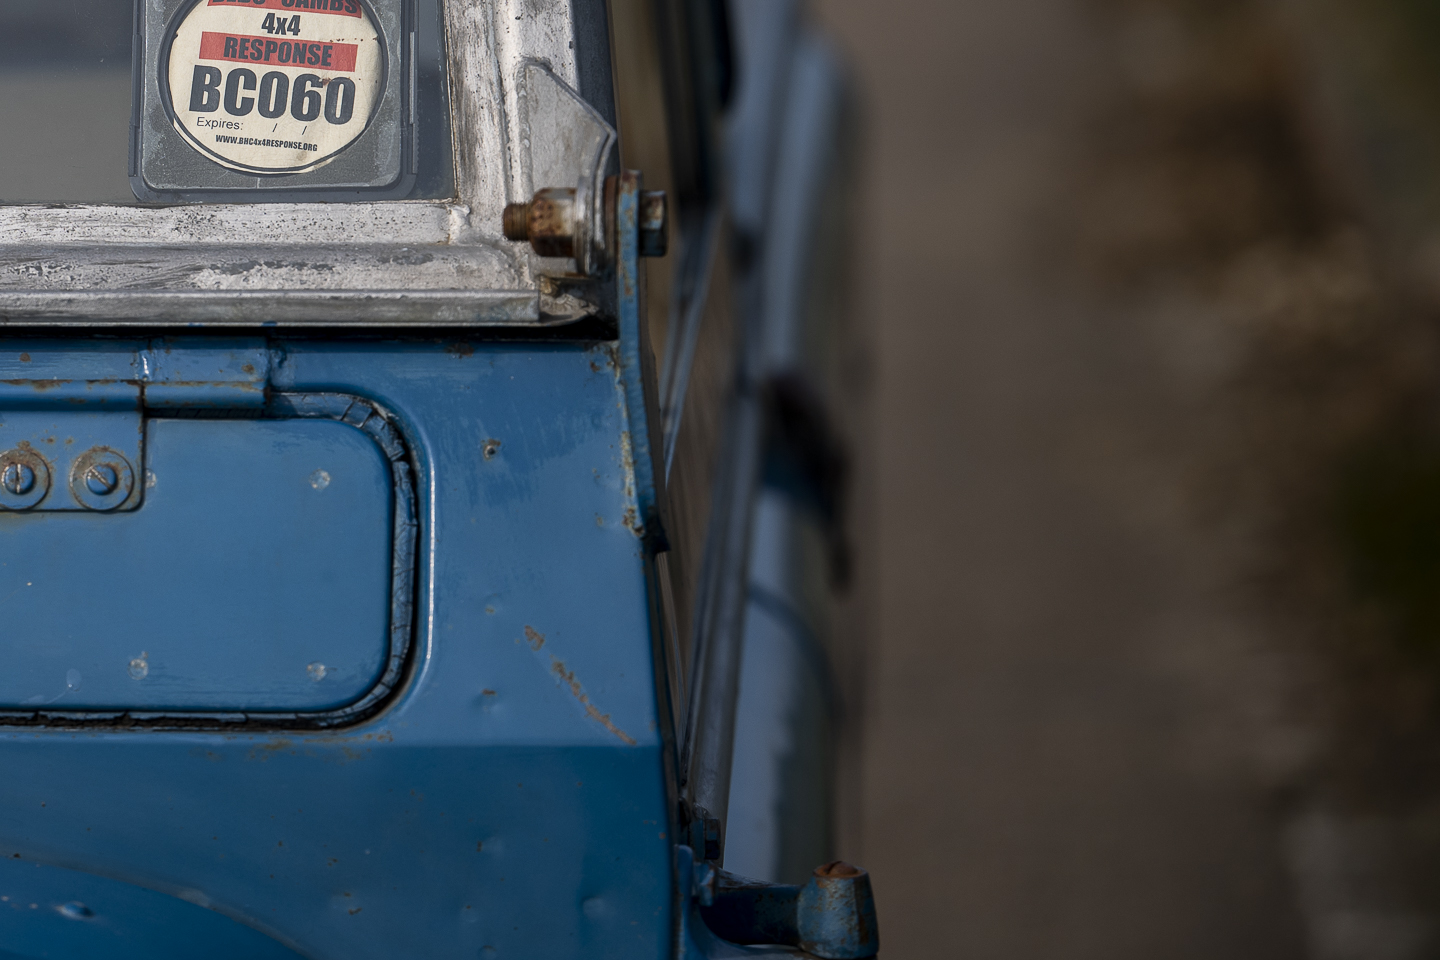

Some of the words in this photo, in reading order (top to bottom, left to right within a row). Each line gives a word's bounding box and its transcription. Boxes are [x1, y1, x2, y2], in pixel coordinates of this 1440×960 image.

[261, 12, 301, 36] 4x4
[223, 36, 333, 67] RESPONSE
[188, 64, 356, 125] BC060
[196, 116, 244, 131] Expires:
